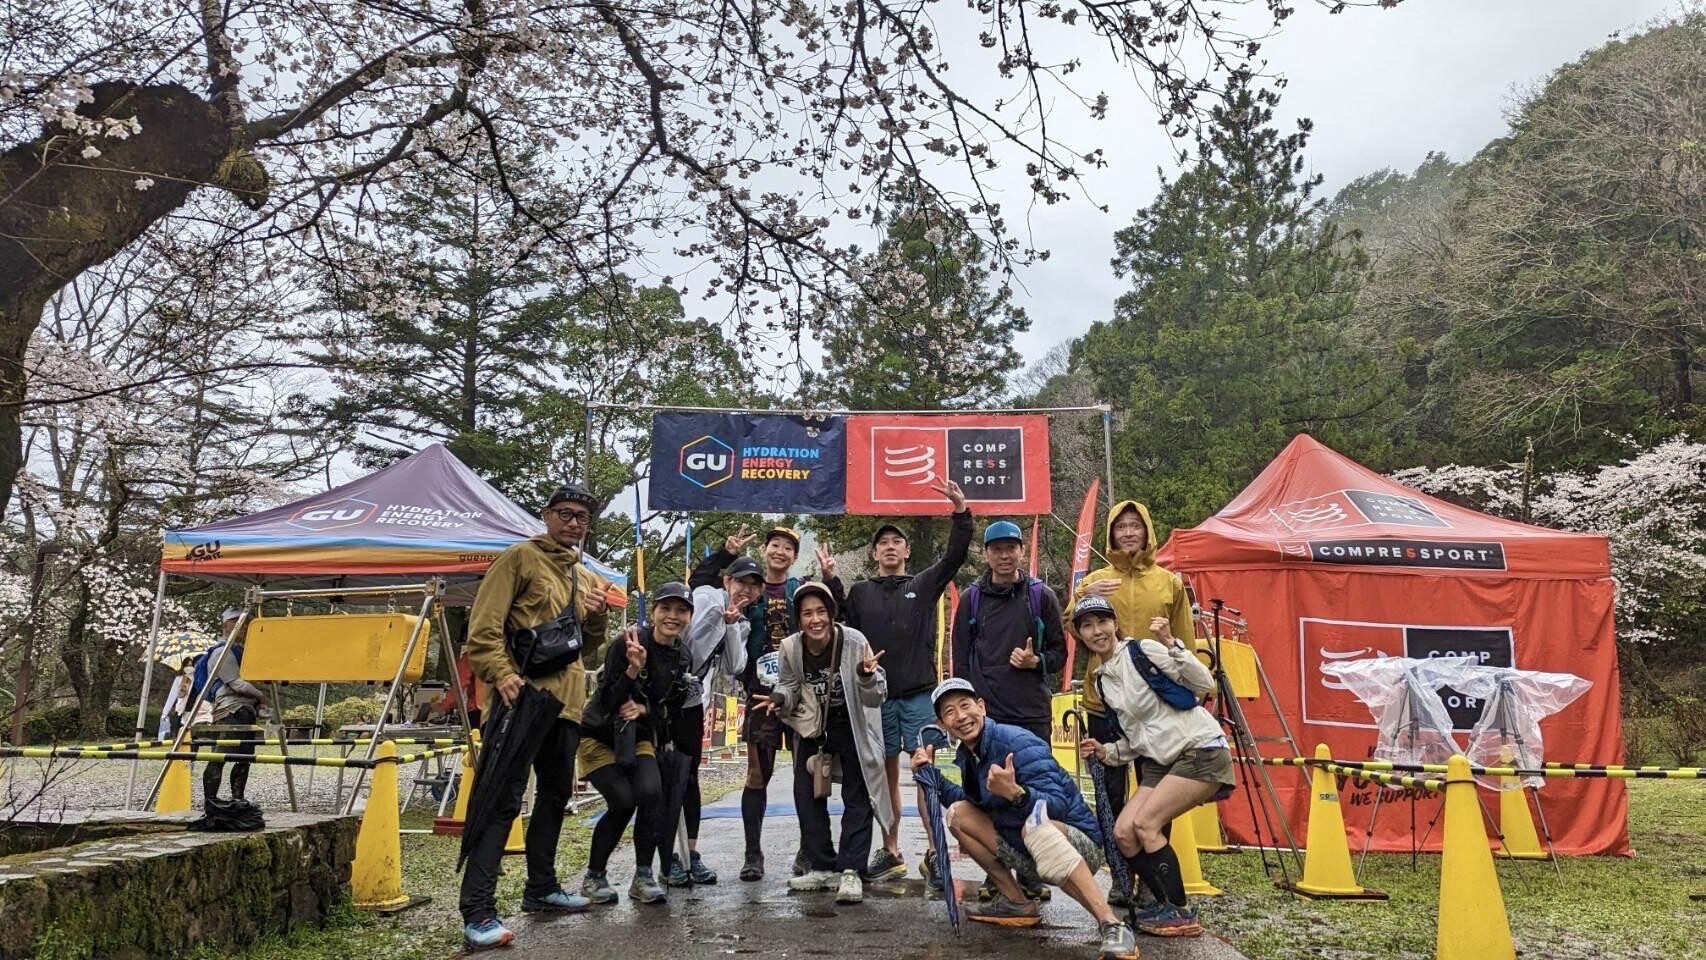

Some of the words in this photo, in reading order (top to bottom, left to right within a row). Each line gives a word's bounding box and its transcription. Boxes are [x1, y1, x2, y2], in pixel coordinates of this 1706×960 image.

[743, 447, 819, 459] HYDRATION
[962, 443, 1007, 453] COMP
[686, 453, 727, 471] GU
[742, 458, 794, 468] ENERGY
[963, 459, 1007, 469] RESS
[741, 468, 810, 480] RECOVERY
[964, 475, 1007, 485] PORT
[302, 509, 365, 521] GU
[381, 510, 448, 521] ENERGY
[375, 517, 464, 528] RECOVERY
[1319, 545, 1490, 562] COMPRESSPORT
